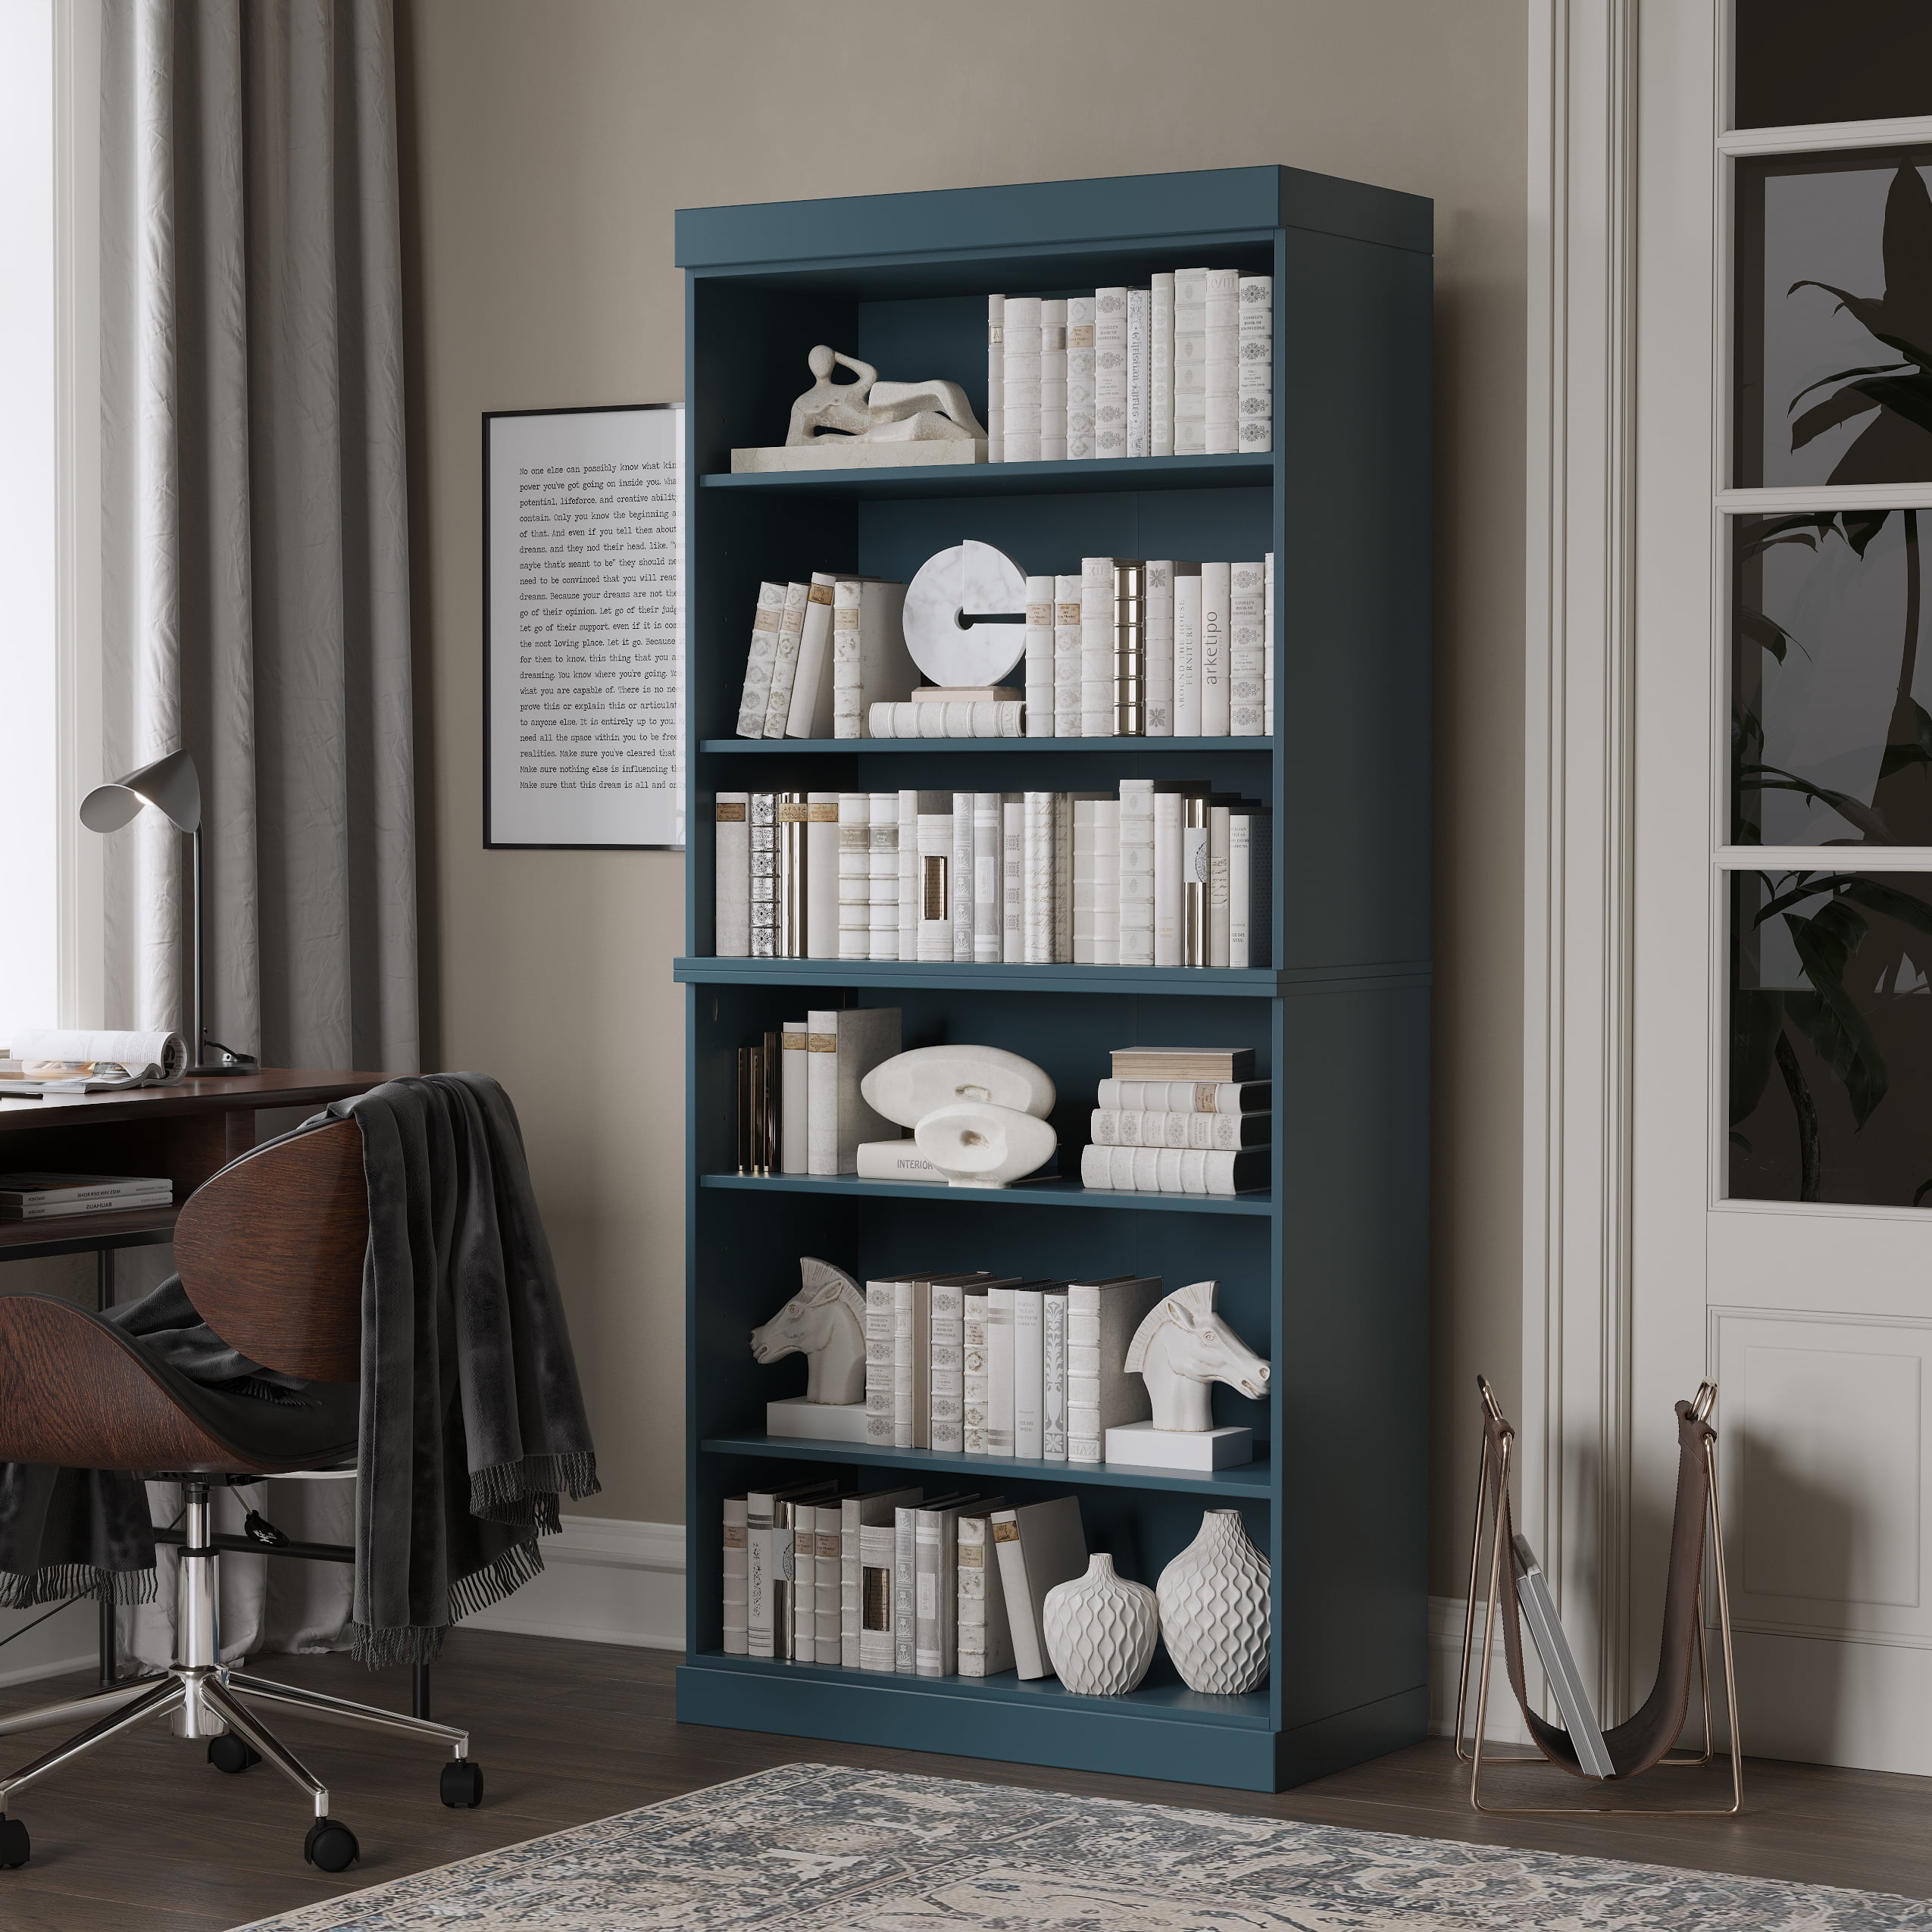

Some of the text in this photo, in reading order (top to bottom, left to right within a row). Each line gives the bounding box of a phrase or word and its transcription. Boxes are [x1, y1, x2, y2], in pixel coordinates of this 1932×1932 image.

[583, 464, 617, 474] possibly
[620, 463, 638, 471] know
[543, 481, 564, 492] you've
[567, 481, 580, 491] got
[583, 480, 604, 490] going
[520, 498, 557, 508] potential,
[554, 514, 571, 522] Only
[575, 514, 588, 522] you
[629, 510, 669, 520] beginning
[567, 545, 583, 553] they
[520, 561, 541, 571] maybe
[619, 559, 636, 567] they
[639, 558, 664, 566] should
[550, 592, 580, 600] Because
[566, 607, 596, 617] opinion.
[555, 639, 579, 649] loving
[582, 638, 604, 648] place.
[1203, 611, 1222, 685] arketipo
[535, 655, 552, 663] them
[609, 655, 631, 664] thing
[520, 671, 555, 680] dreaming.
[595, 670, 616, 678] where
[619, 670, 641, 679] you're
[645, 670, 667, 679] going.
[574, 686, 602, 696] capable
[618, 685, 639, 693] There
[575, 702, 605, 711] explain
[602, 717, 633, 727] entirely
[571, 734, 592, 742] space
[601, 749, 623, 758] you've
[560, 765, 589, 774] nothing
[622, 765, 667, 774] influencing
